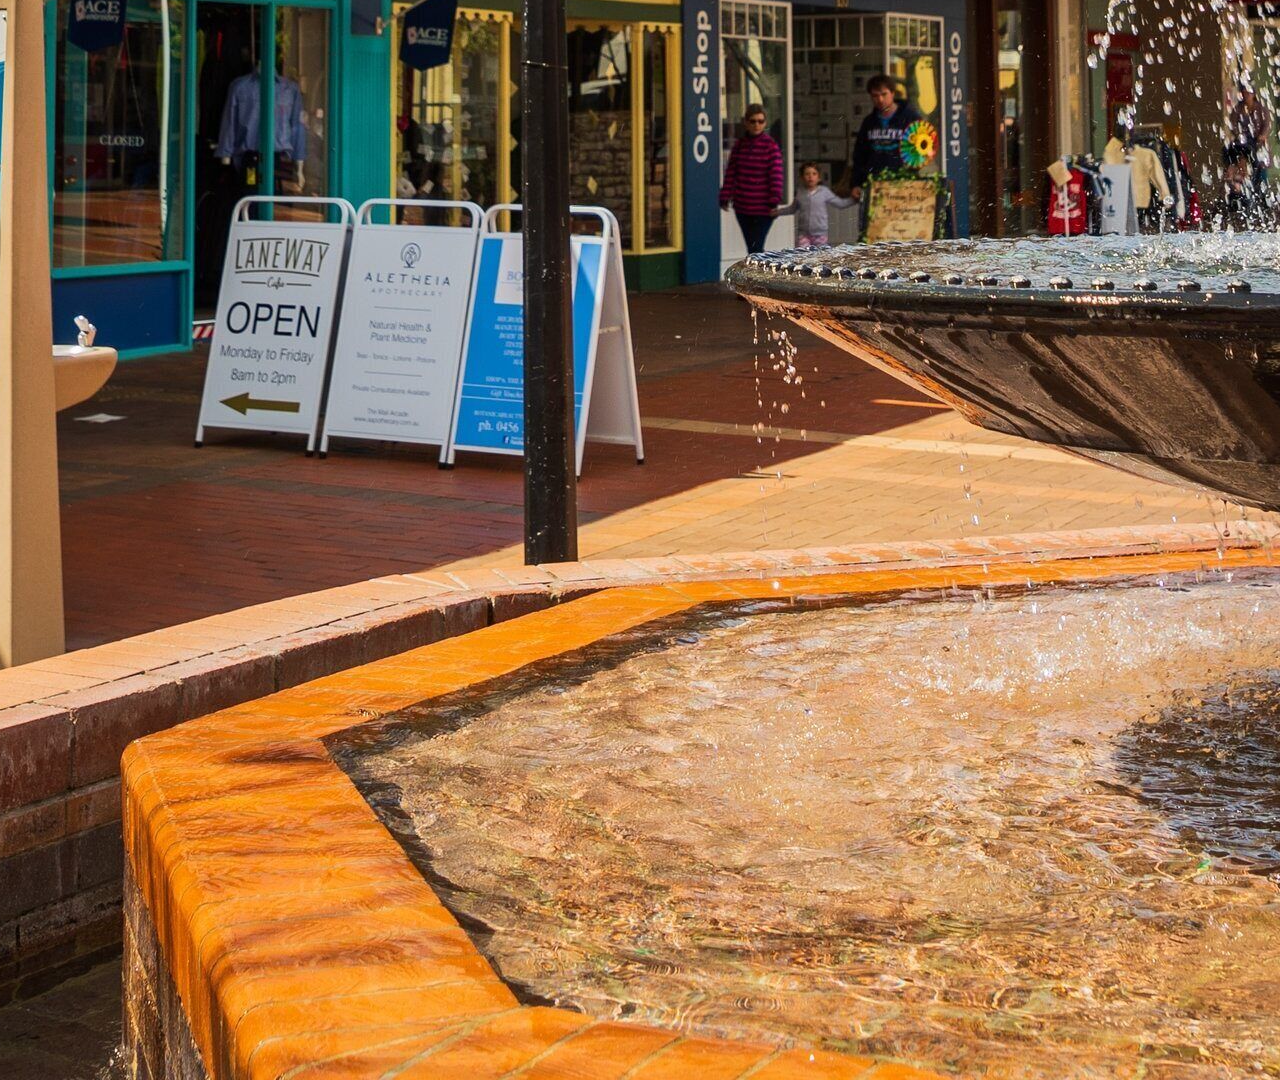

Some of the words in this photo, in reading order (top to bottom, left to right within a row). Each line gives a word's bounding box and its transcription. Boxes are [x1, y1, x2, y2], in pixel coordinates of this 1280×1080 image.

[85, 0, 120, 15] ACE
[416, 27, 448, 40] ACE
[692, 9, 713, 164] Op-Shop
[949, 31, 963, 158] Op-Shop
[99, 135, 145, 147] CLOSED
[235, 238, 329, 272] LANEWAY
[364, 272, 451, 286] ALETHEIA
[371, 288, 443, 298] APOTHECARY
[226, 301, 321, 338] OPEN
[369, 320, 397, 331] Natural
[398, 322, 424, 332] Health
[370, 332, 391, 342] Plant
[392, 333, 428, 345] Medicine
[220, 344, 263, 362] Monday
[266, 348, 277, 360] to
[280, 348, 314, 366] Friday
[230, 368, 255, 381] 8am
[258, 370, 270, 382] to
[270, 370, 297, 385] 2pm
[478, 420, 493, 432] ph.
[496, 421, 519, 433] 0456
